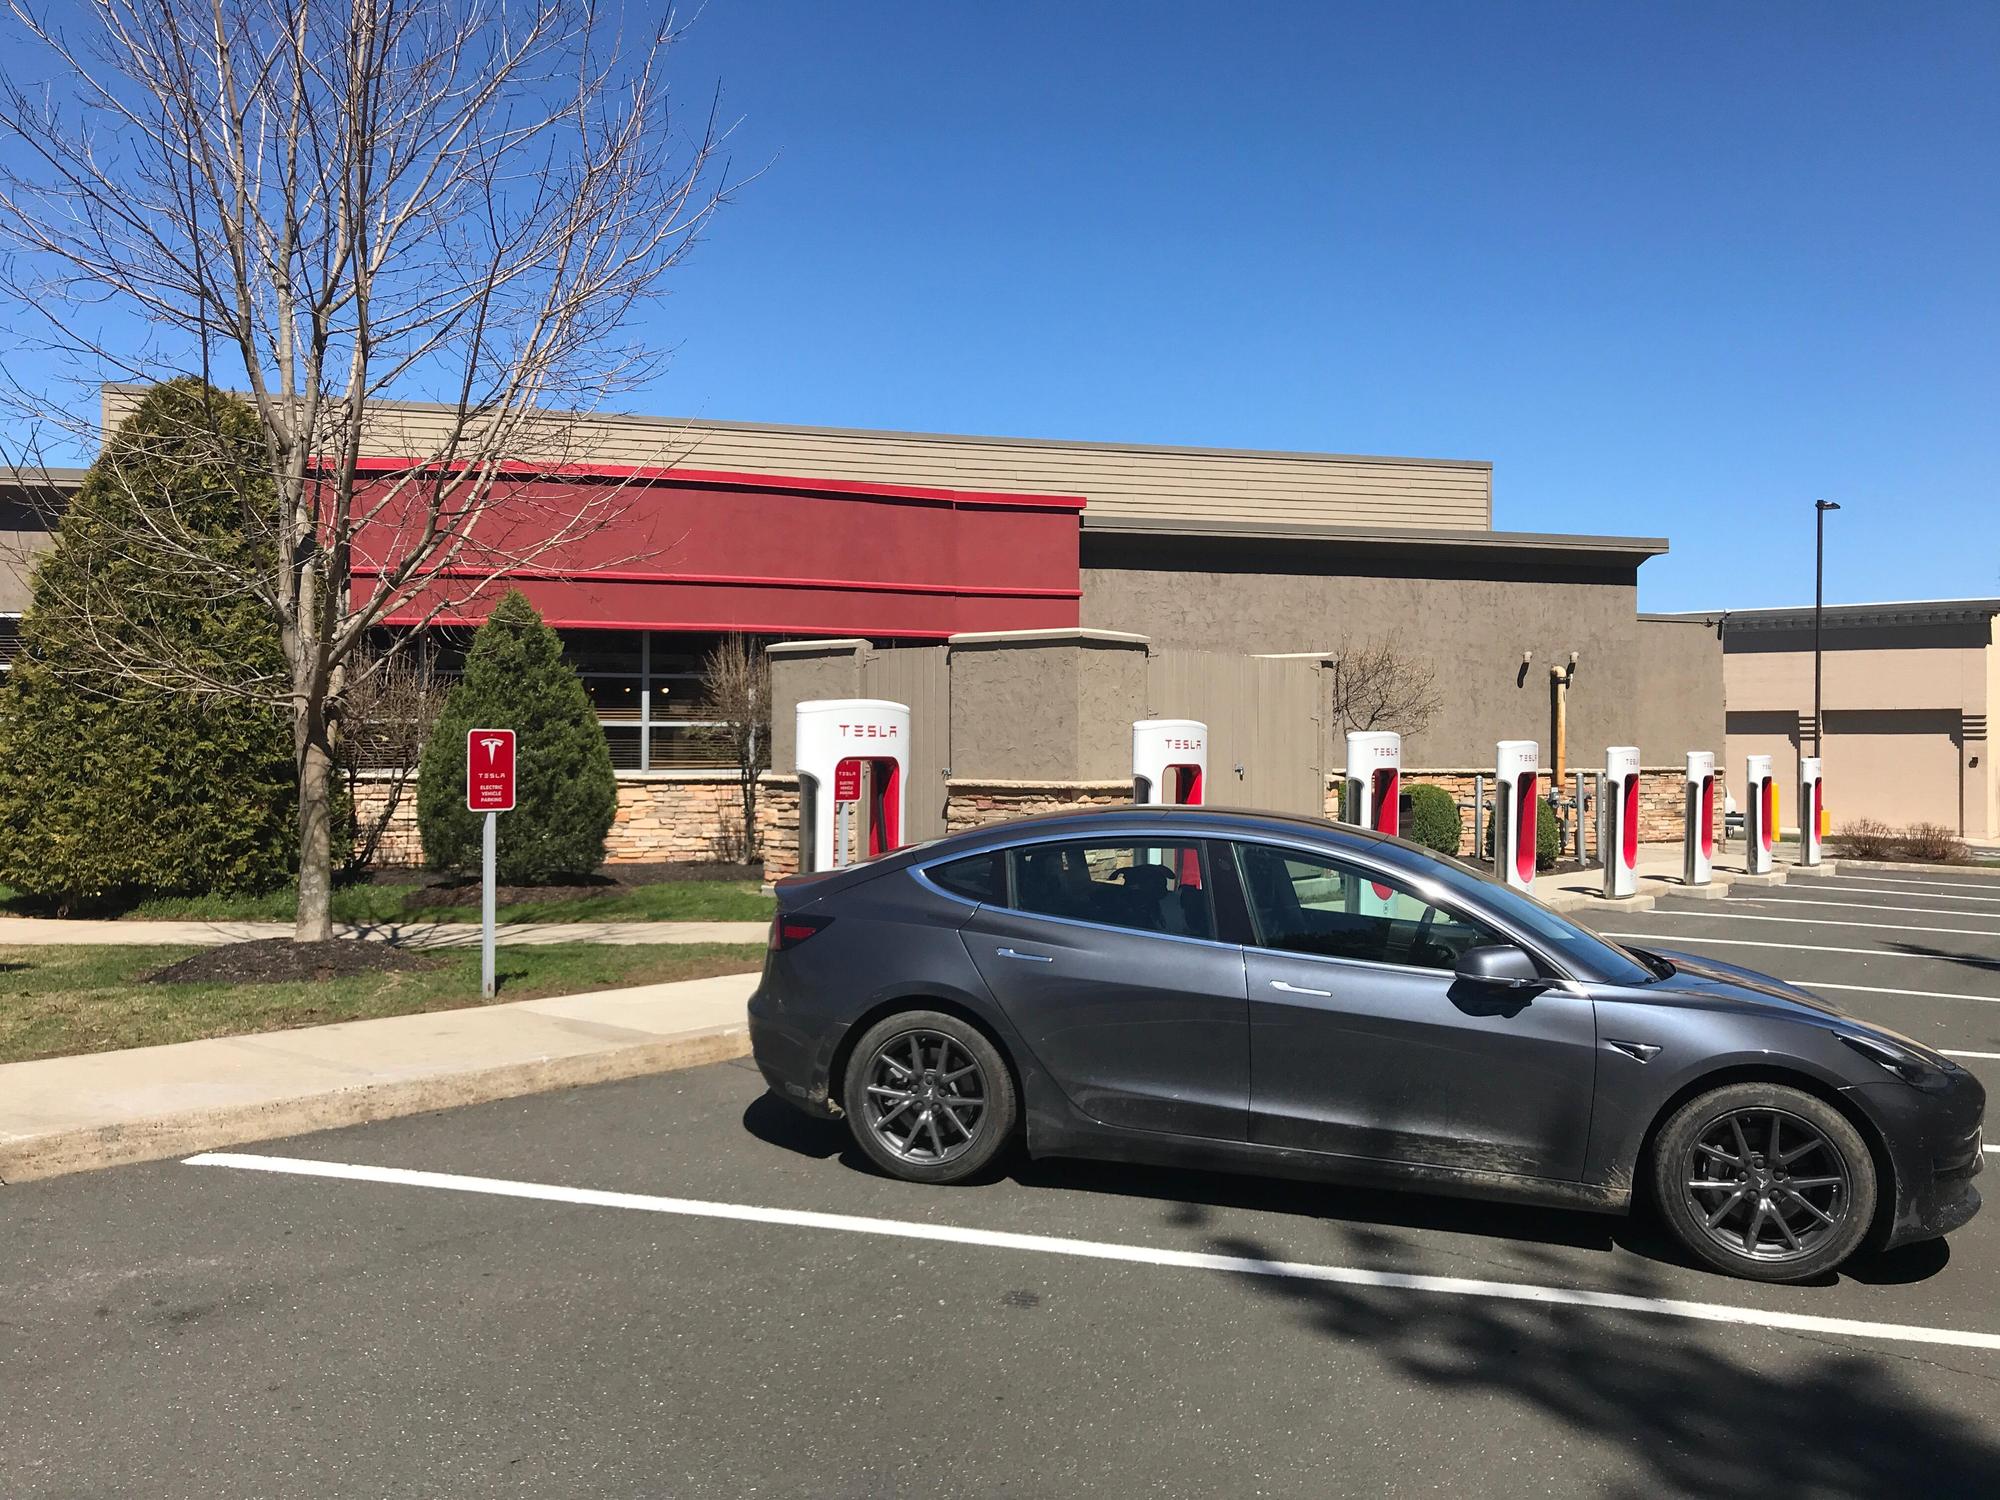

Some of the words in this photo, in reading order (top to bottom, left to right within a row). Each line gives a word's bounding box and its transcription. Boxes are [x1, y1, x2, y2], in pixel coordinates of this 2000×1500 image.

[839, 724, 897, 738] TESLA
[1165, 739, 1202, 750] TESLA
[1373, 747, 1398, 756] TESLA
